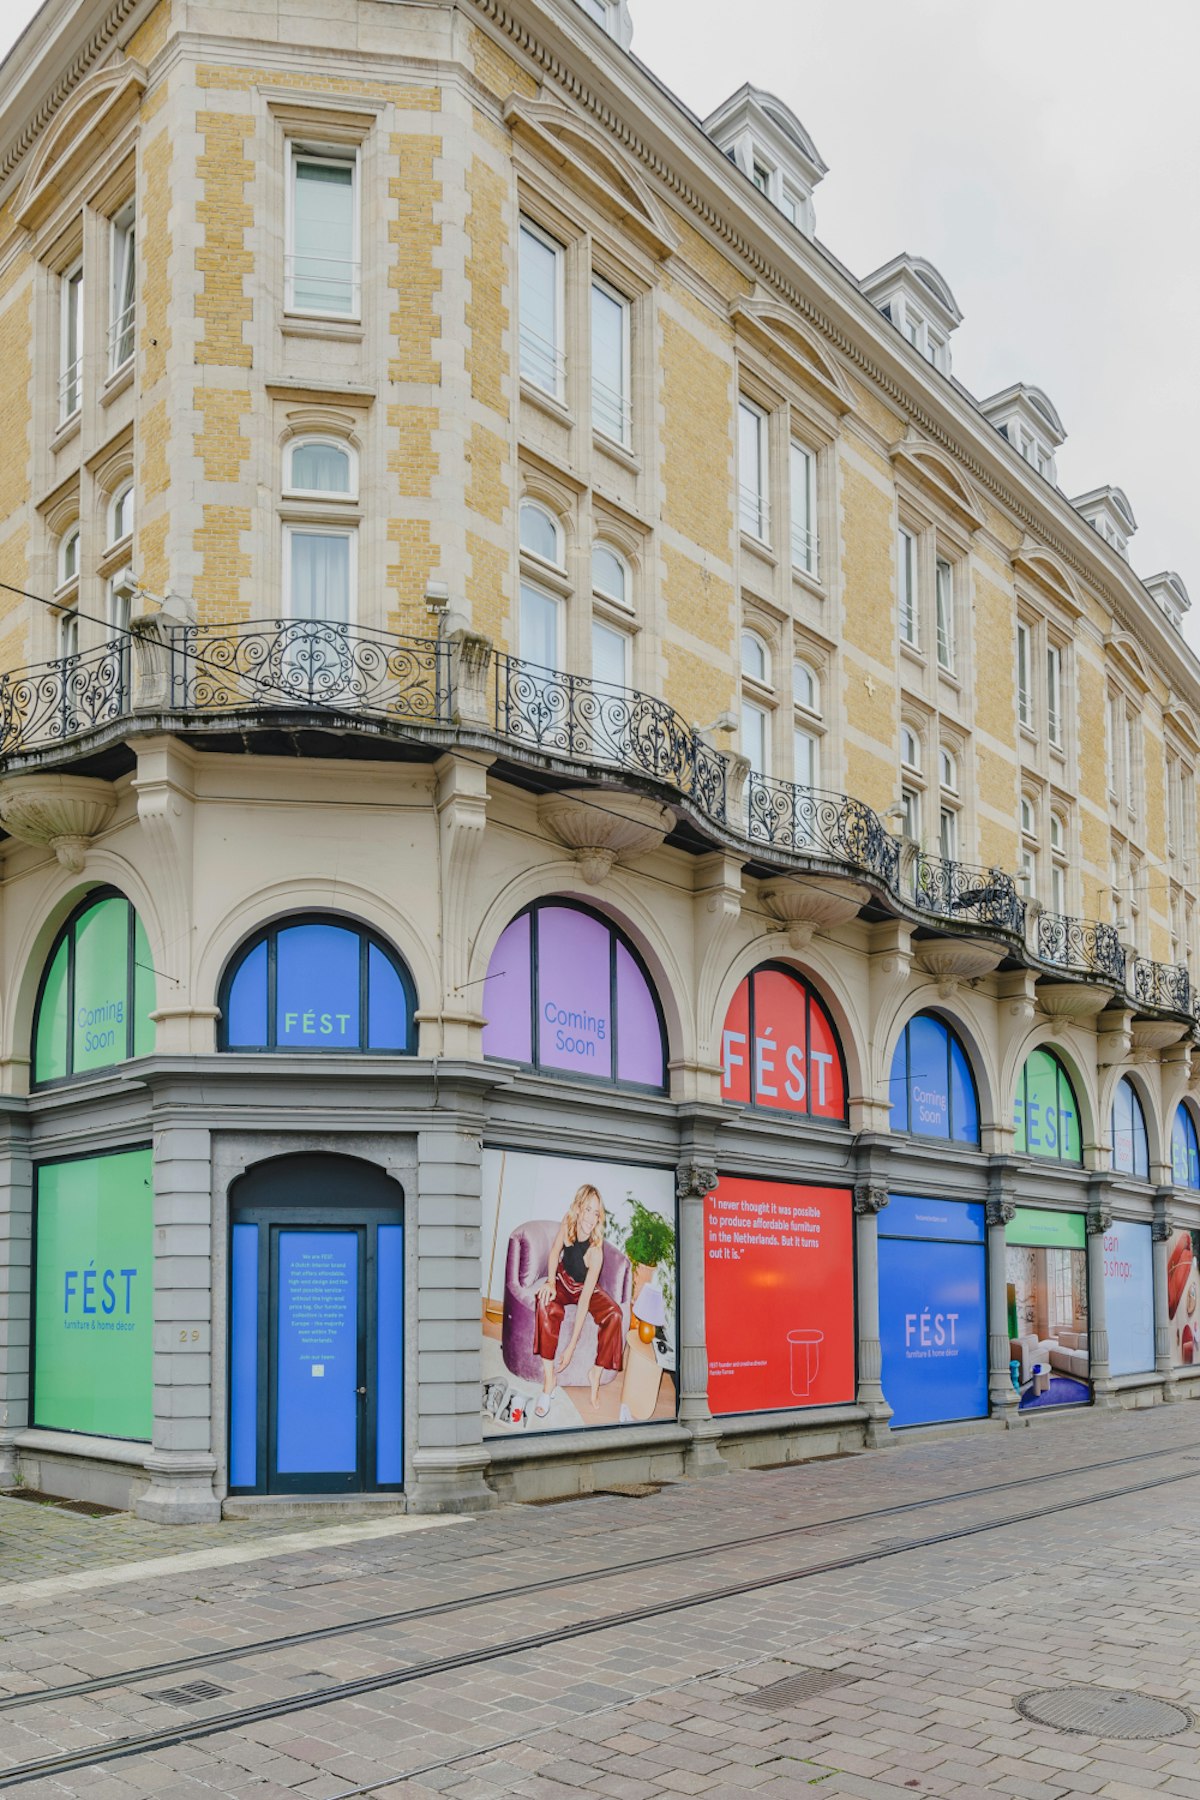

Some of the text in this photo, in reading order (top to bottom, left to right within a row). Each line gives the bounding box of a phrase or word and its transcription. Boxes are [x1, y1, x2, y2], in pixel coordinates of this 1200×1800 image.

[78, 1000, 123, 1028] Coming
[285, 1008, 351, 1035] FÉST
[544, 1002, 606, 1040] Coming
[84, 1030, 115, 1052] Soon
[555, 1029, 595, 1057] Soon
[722, 1026, 833, 1106] FÉST
[912, 1086, 946, 1112] Coming
[919, 1105, 941, 1124] Soon
[718, 1200, 739, 1211] never
[740, 1200, 770, 1215] thought
[771, 1202, 777, 1214] it
[778, 1206, 791, 1216] was
[793, 1206, 821, 1218] possible
[709, 1214, 820, 1233] to produce affordable furniture
[709, 1230, 819, 1249] in the Netherlands. But it turns
[1103, 1235, 1118, 1252] can
[709, 1248, 722, 1259] out
[724, 1247, 730, 1259] it
[64, 1259, 137, 1314] FÉST
[64, 1319, 90, 1330] furniture
[90, 1319, 96, 1330] &
[96, 1320, 114, 1331] home
[905, 1306, 959, 1347] FÉST
[905, 1349, 927, 1358] furniture
[932, 1349, 945, 1357] home
